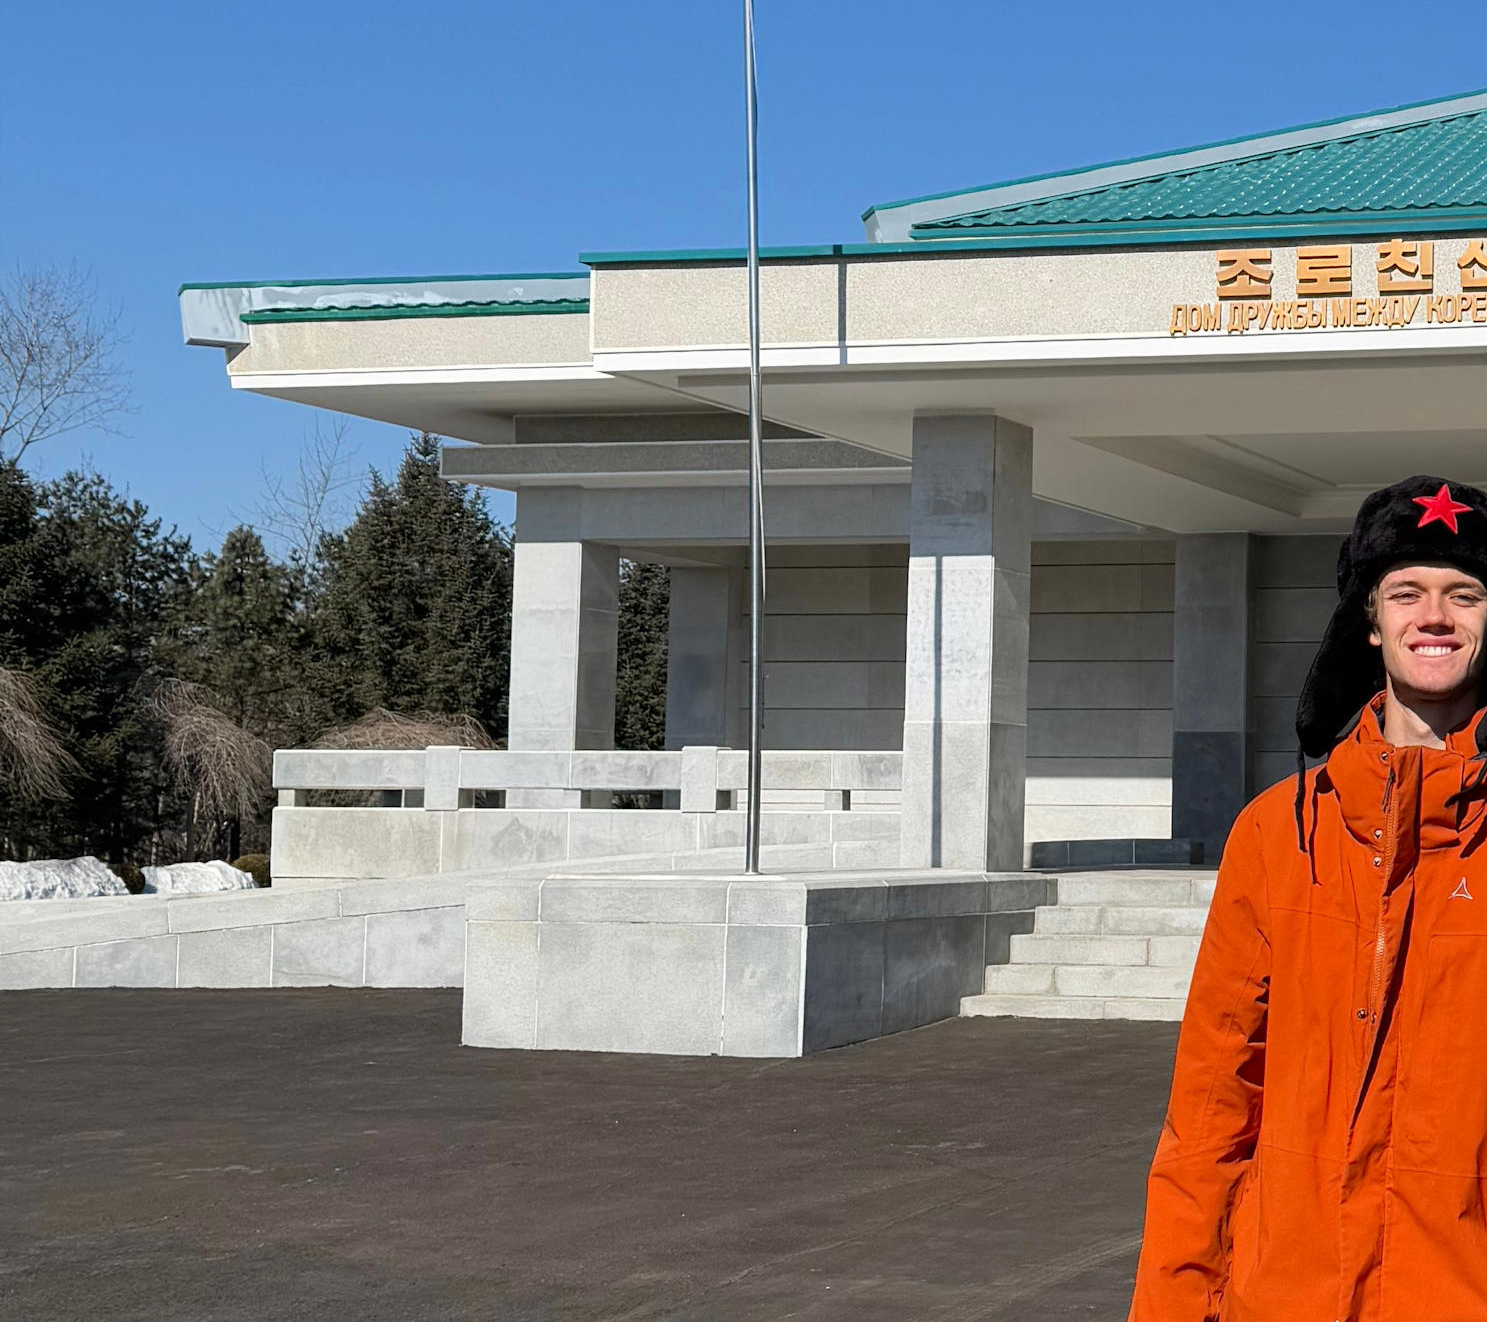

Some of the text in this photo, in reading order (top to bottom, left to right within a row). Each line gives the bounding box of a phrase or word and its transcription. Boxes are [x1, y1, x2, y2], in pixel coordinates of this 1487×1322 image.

[1169, 303, 1222, 337] ДОМ
[1227, 298, 1328, 337] ДРУЖБЫ
[1331, 294, 1422, 330] МЕЖДУ
